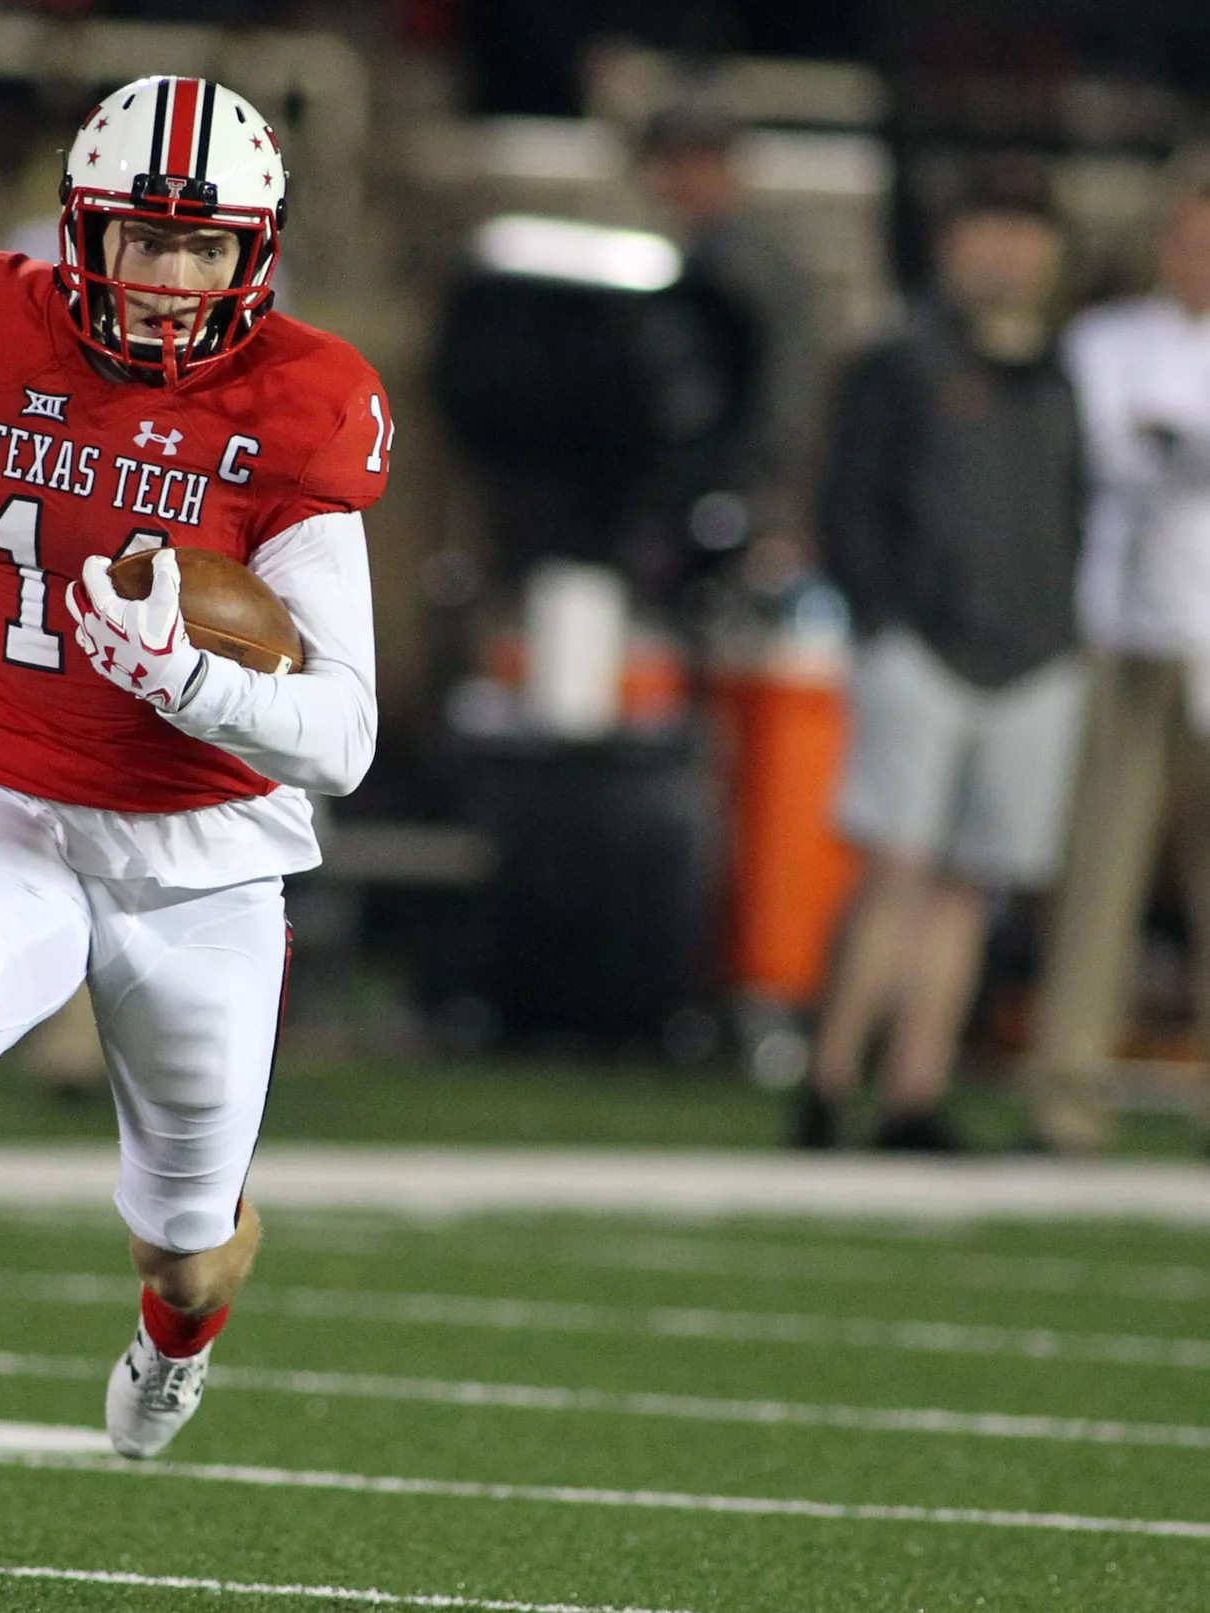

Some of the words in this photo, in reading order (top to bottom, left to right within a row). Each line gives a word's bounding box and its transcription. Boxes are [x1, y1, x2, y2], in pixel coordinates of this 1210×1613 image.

[217, 434, 261, 487] C
[365, 391, 395, 475] 1
[112, 455, 209, 526] TECH
